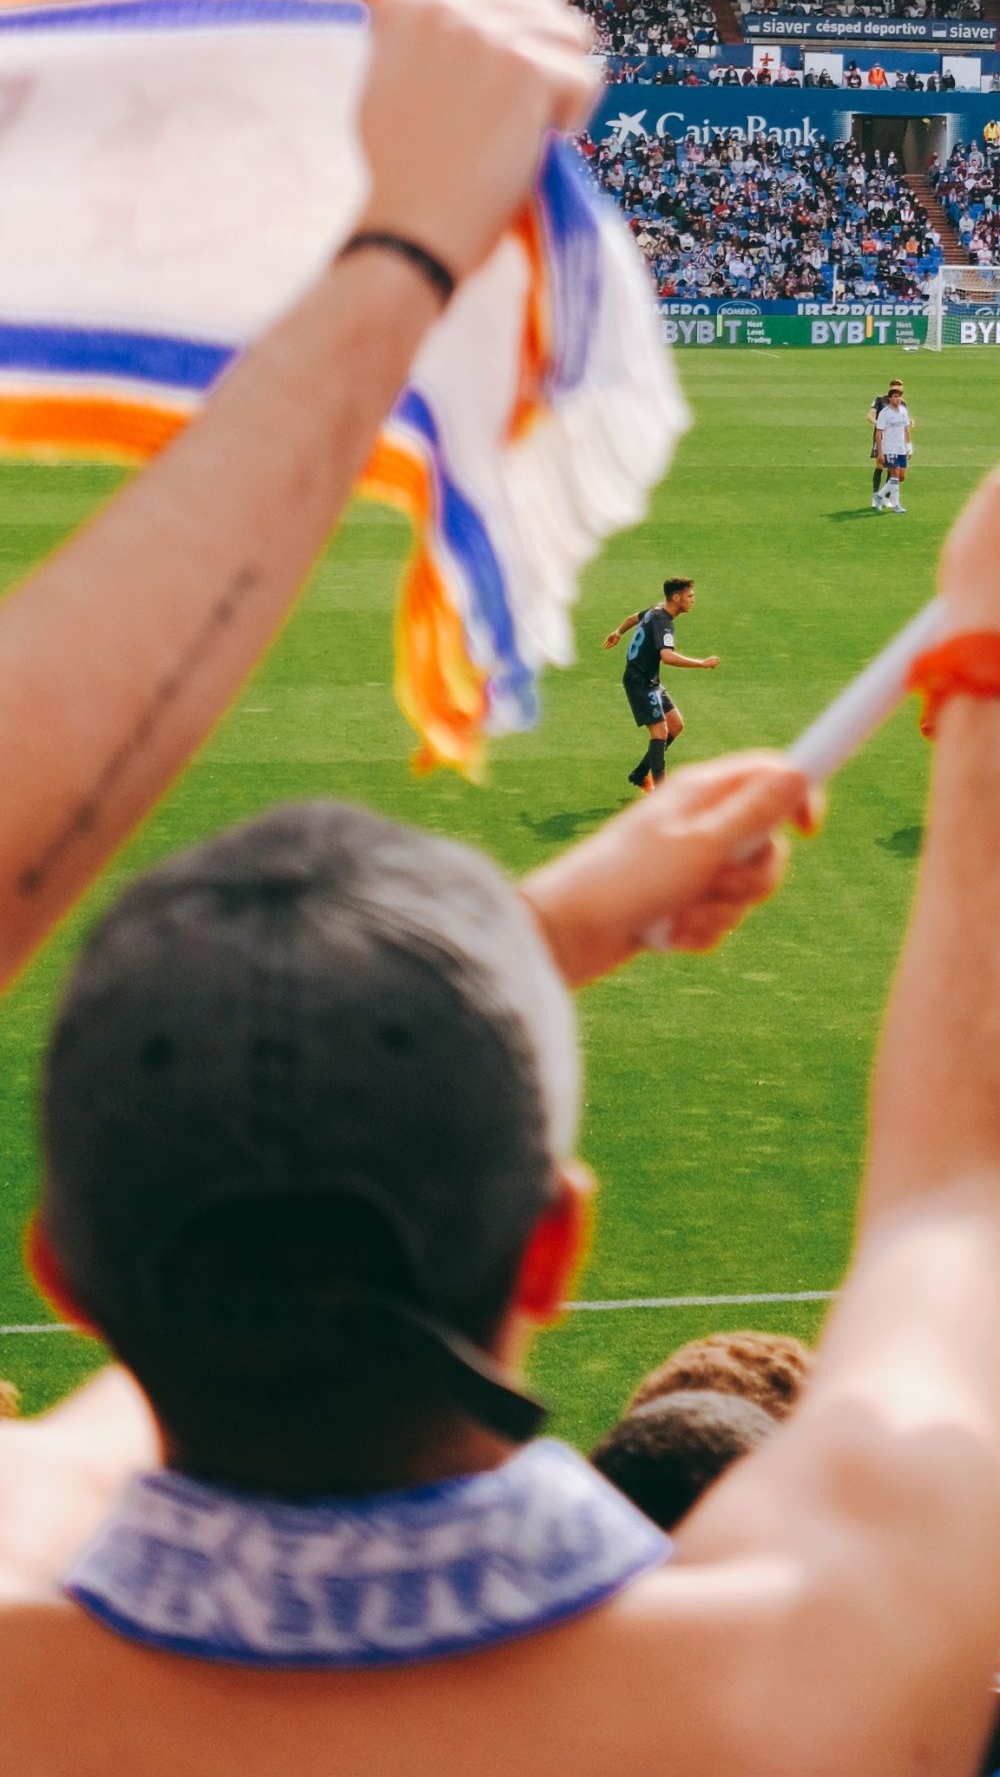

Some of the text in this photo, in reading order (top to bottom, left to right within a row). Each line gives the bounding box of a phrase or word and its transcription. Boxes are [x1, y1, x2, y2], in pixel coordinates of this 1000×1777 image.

[762, 18, 997, 39] siaver césped deportivo siaver
